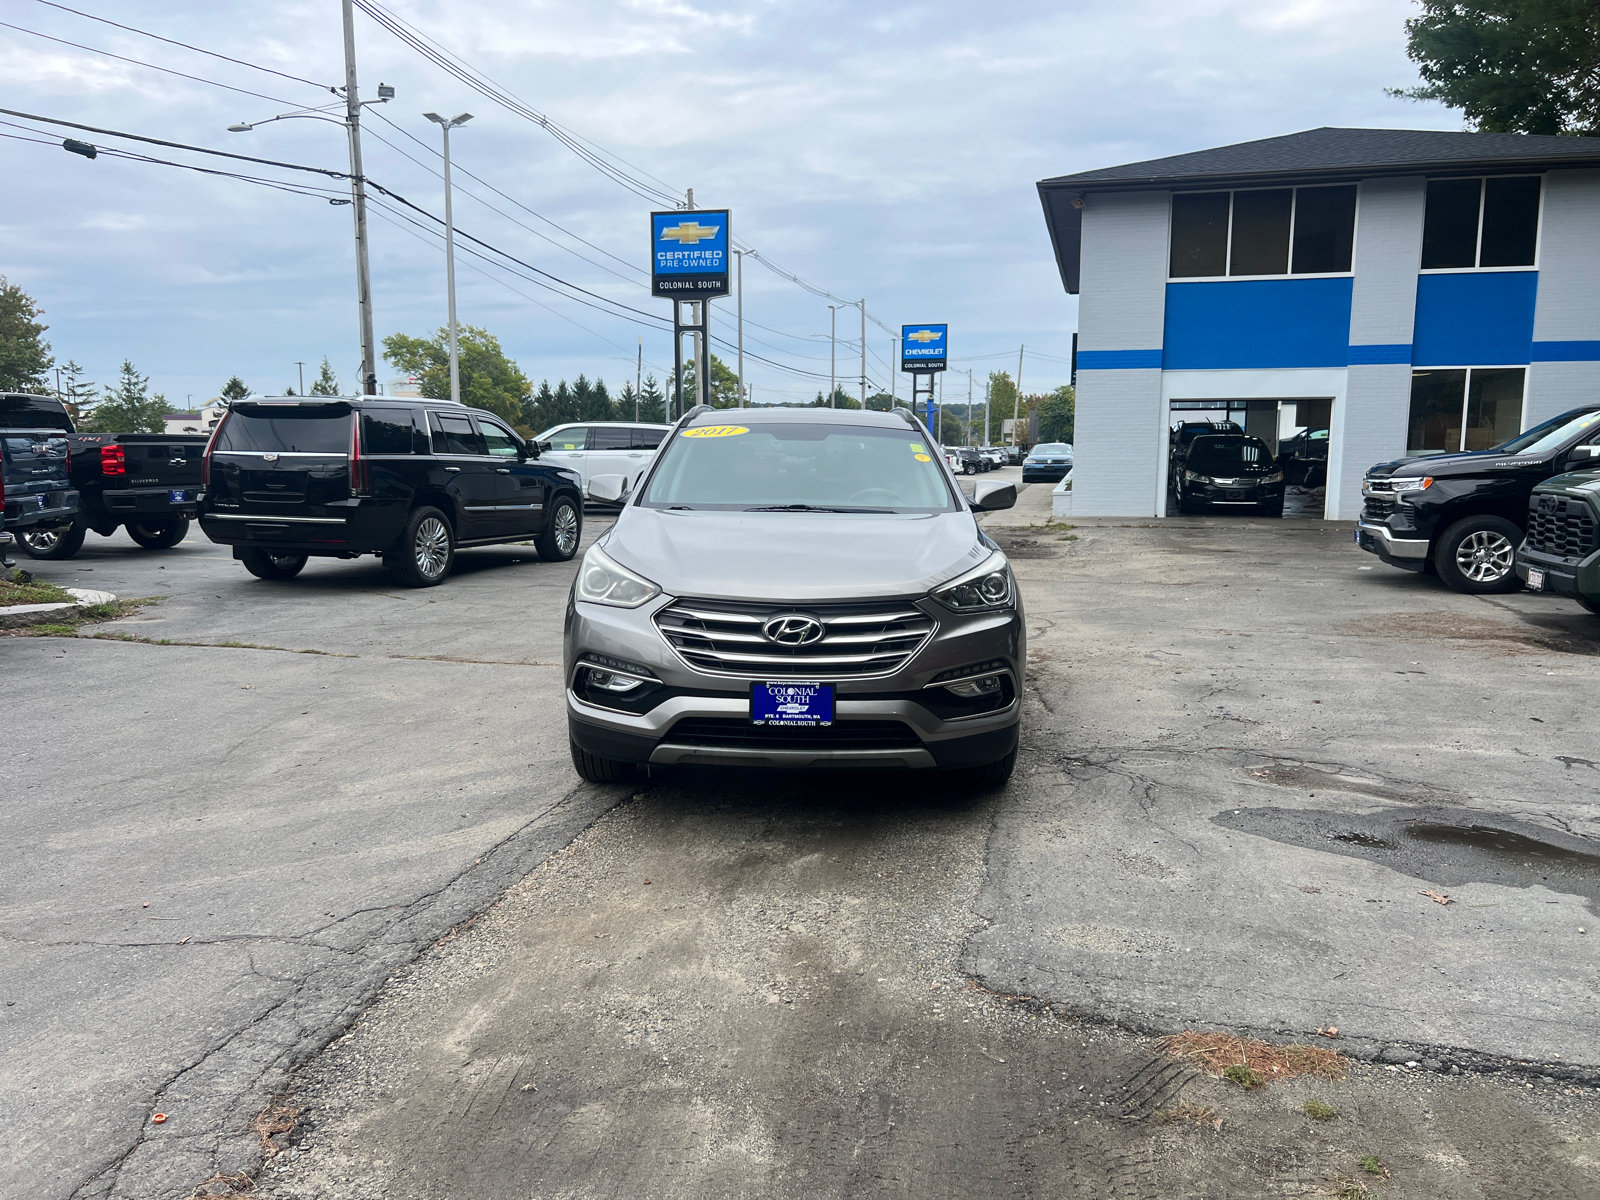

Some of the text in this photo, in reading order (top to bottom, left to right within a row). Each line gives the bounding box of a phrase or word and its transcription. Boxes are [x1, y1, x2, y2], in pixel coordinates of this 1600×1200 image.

[657, 250, 723, 260] CERTIFIED
[660, 259, 719, 268] PRE-OWNED
[659, 281, 721, 289] COLONIAL SOUTH
[905, 348, 944, 356] CHEVROLET
[691, 427, 738, 437] 2017
[768, 687, 817, 696] COLONIAL
[775, 695, 810, 704] SOUTH
